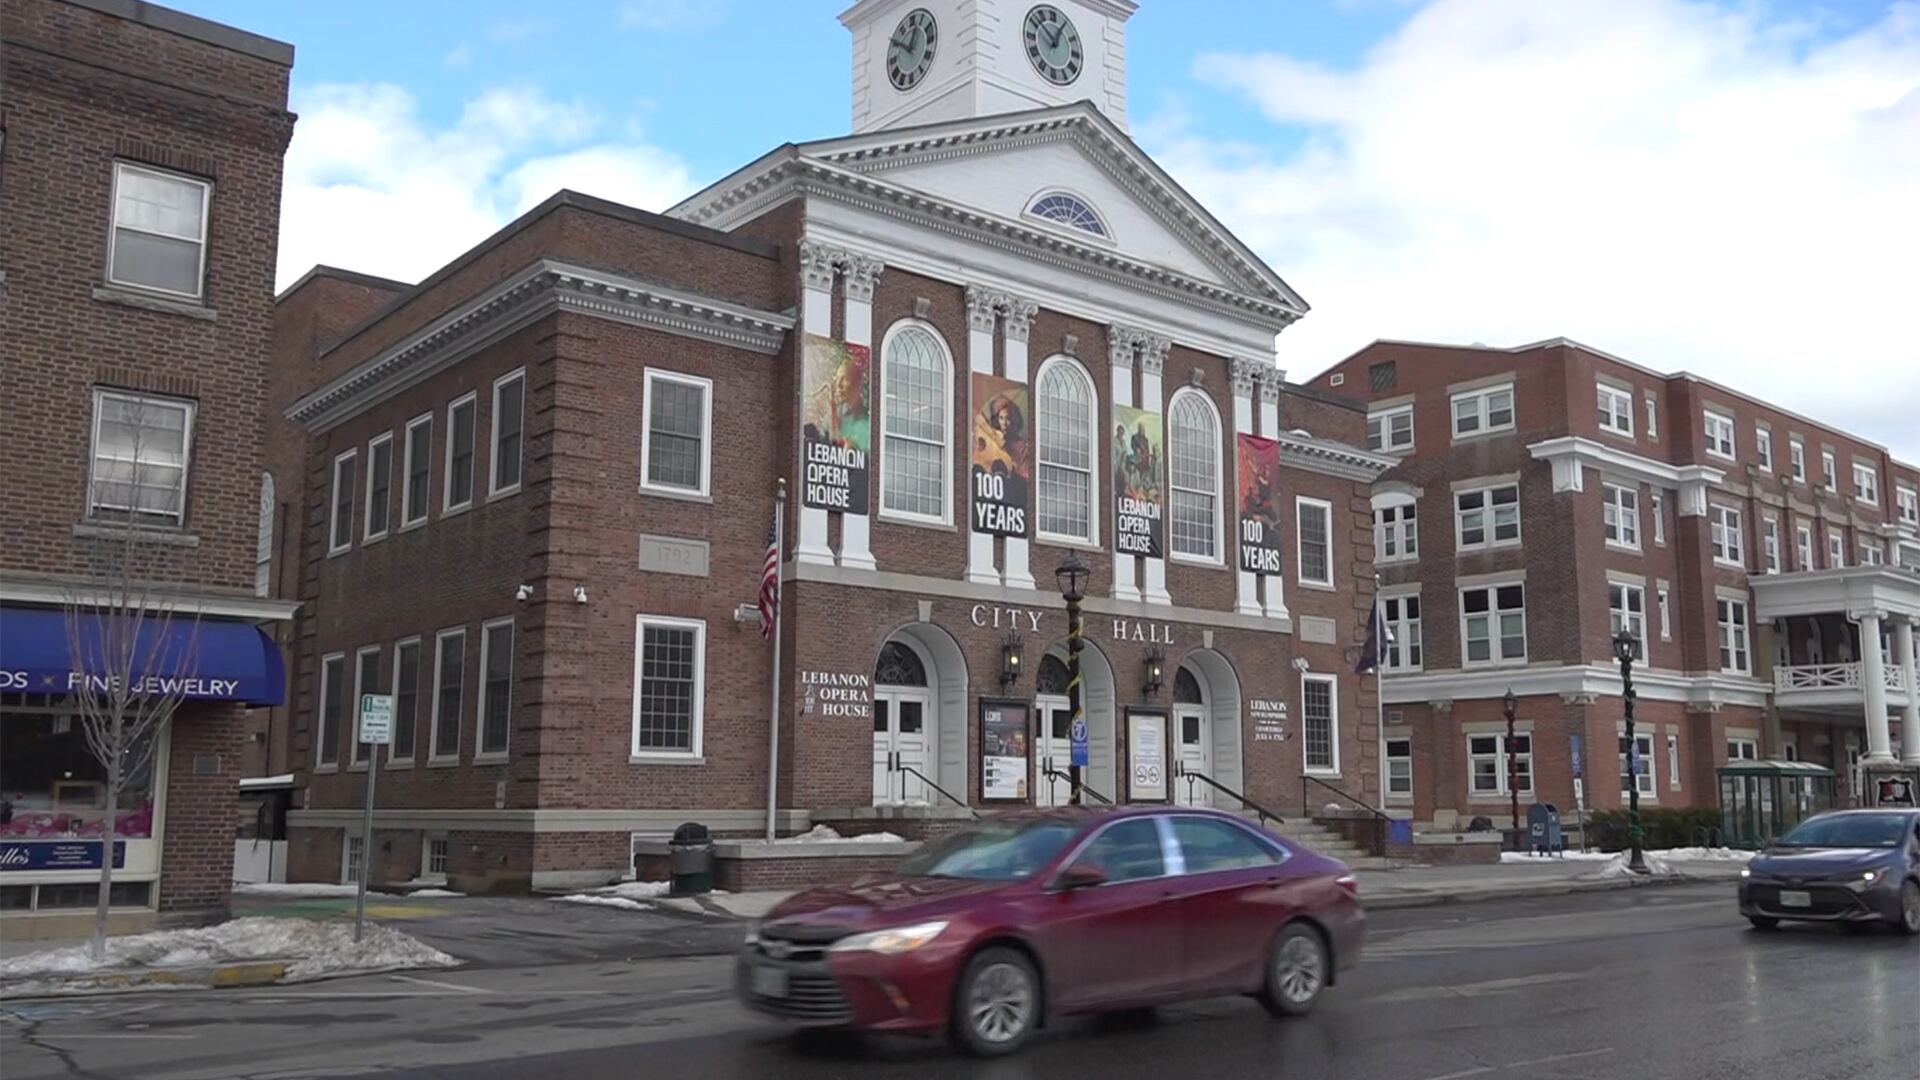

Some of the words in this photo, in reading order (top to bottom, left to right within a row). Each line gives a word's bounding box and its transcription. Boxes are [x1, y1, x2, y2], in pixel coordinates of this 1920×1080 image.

[808, 442, 865, 469] LEBANON
[808, 464, 849, 487] OPERA
[975, 472, 1003, 500] 100
[807, 484, 850, 508] HOUSE
[975, 502, 1025, 534] YEARS
[1118, 497, 1161, 520] LEBANON
[1118, 515, 1151, 534] OPERA
[1242, 519, 1263, 543] 100
[1118, 533, 1151, 553] HOUSE
[1242, 545, 1280, 572] YEARS
[971, 605, 1043, 632] CITY
[1112, 619, 1174, 645] HALL
[67, 672, 121, 692] FINE
[131, 675, 239, 696] JEWELRY
[802, 671, 869, 687] LEBANON
[820, 687, 868, 702] OPERA
[823, 703, 869, 717] HOUSE
